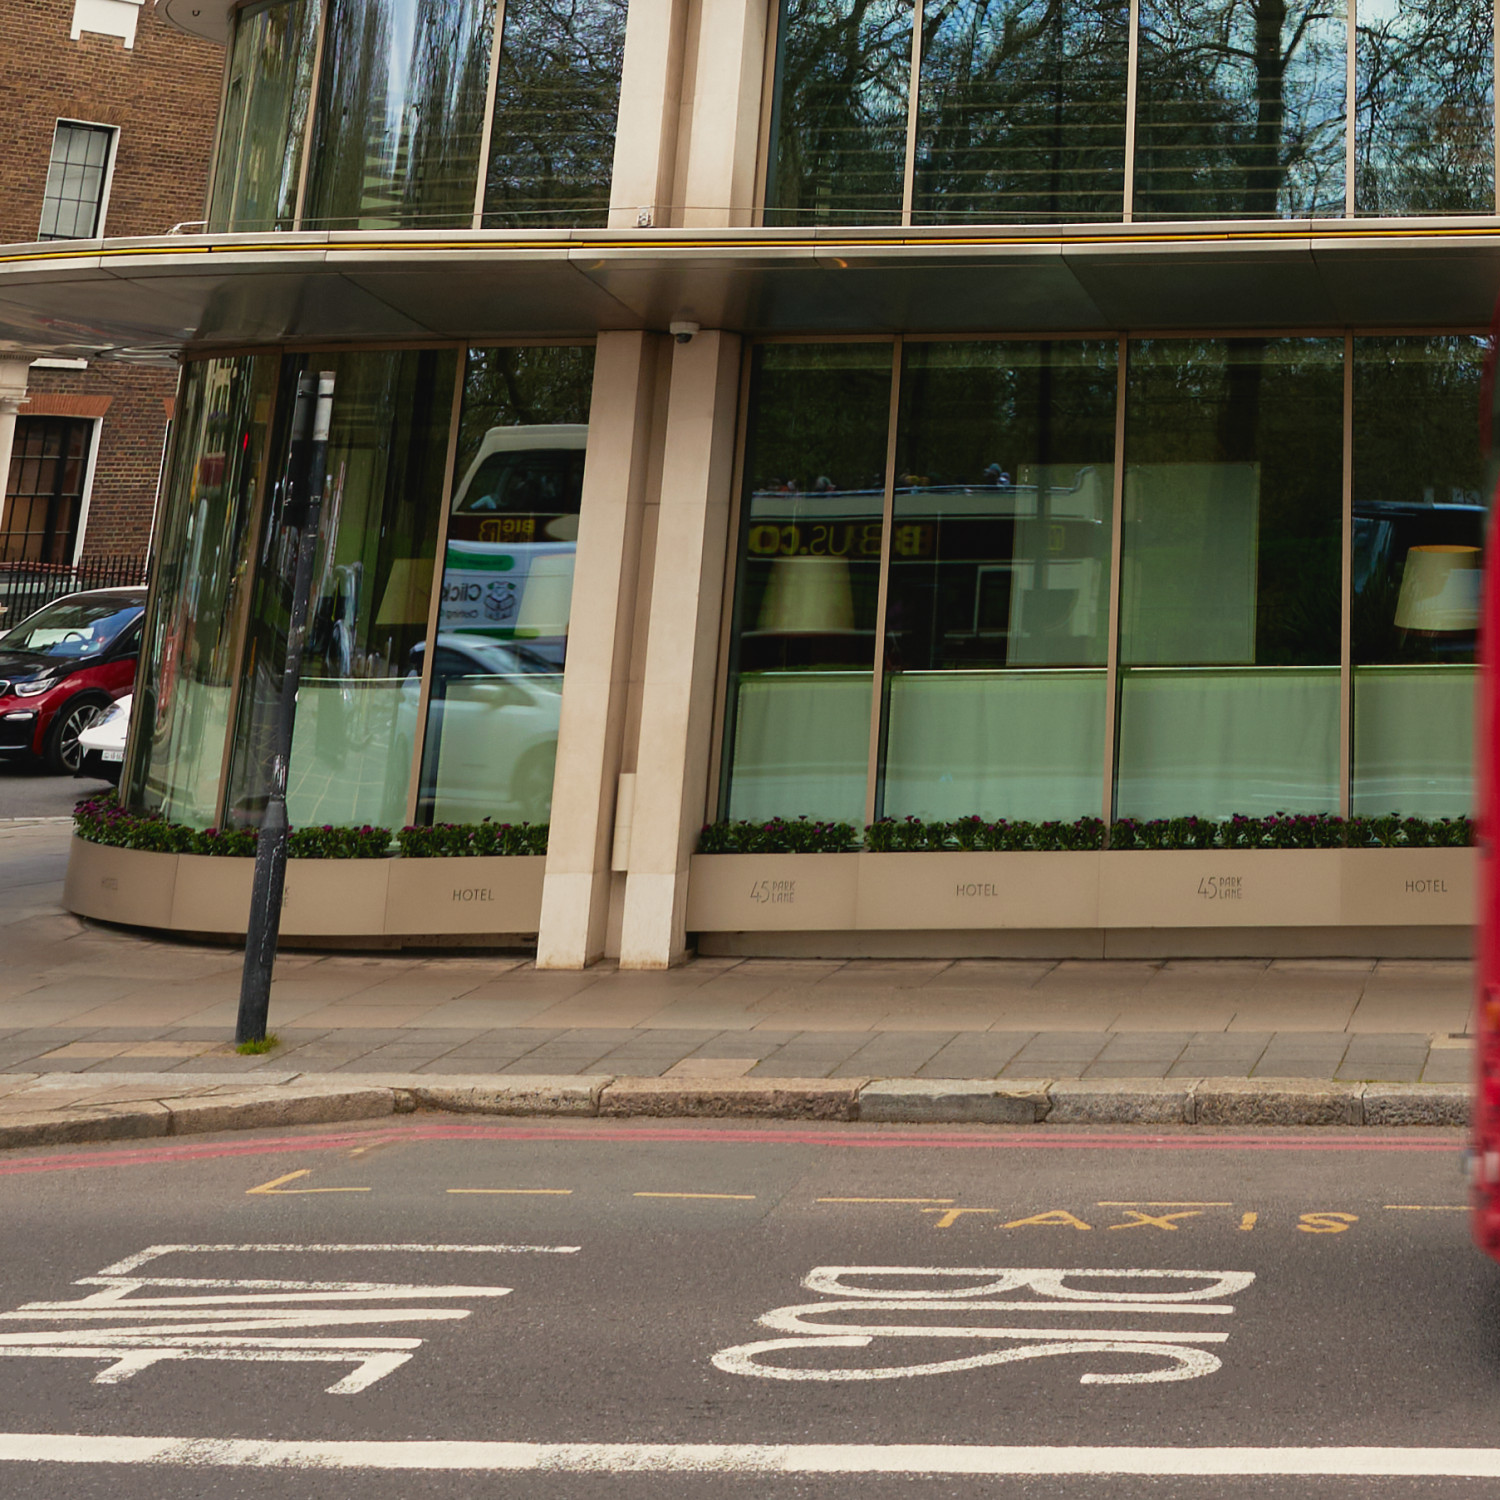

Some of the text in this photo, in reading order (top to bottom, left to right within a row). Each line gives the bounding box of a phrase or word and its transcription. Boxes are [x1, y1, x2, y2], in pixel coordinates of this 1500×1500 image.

[750, 880, 796, 904] 45 PARK
[956, 883, 998, 897] HOTEL
[1197, 876, 1243, 900] 45 PARK
[1405, 879, 1448, 893] HOTEL
[452, 888, 495, 901] HOTEL
[771, 892, 795, 904] LANE
[1218, 888, 1242, 900] LANE
[919, 1207, 1360, 1234] TAXIS
[711, 1265, 1256, 1385] BUS
